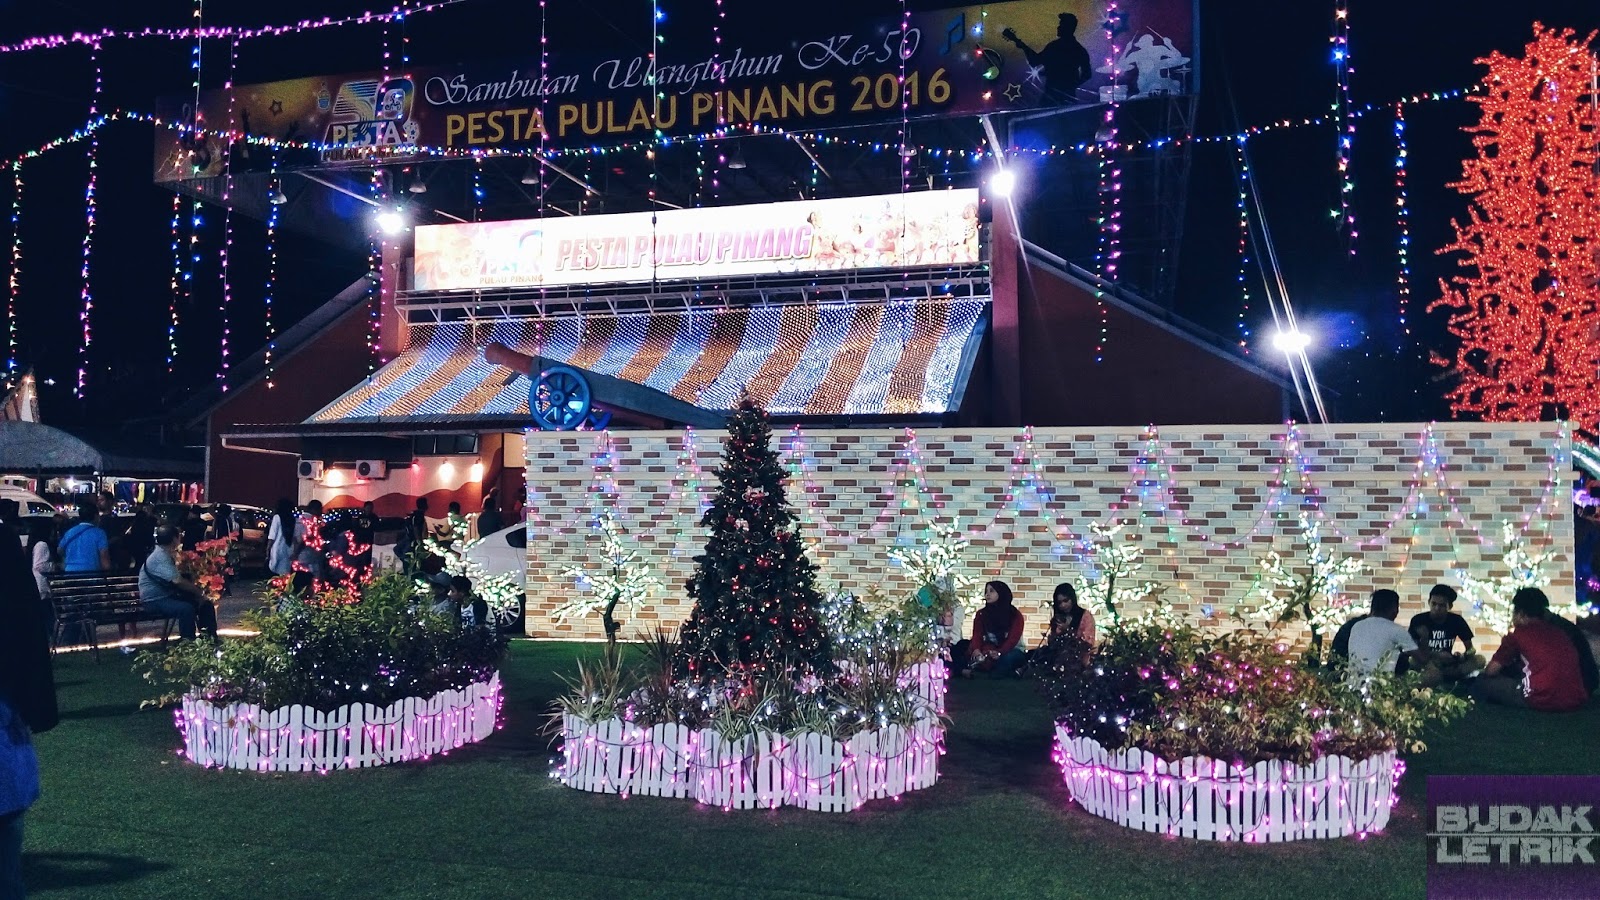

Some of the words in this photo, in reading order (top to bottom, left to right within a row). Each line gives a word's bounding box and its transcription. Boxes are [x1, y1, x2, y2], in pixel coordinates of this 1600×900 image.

[424, 70, 580, 105] Sambutan
[593, 48, 783, 95] Ulangtahun
[798, 28, 921, 69] Ke-50
[446, 107, 547, 146] PESTA
[559, 95, 677, 137] PULAU
[692, 80, 836, 126] PINANG
[850, 67, 951, 112] 2016
[332, 121, 403, 148] PESTA
[554, 236, 630, 271] PESTA
[631, 231, 713, 267] PULAU
[714, 224, 814, 264] PINANG
[480, 276, 507, 285] PULAU
[511, 274, 544, 283] PINANG
